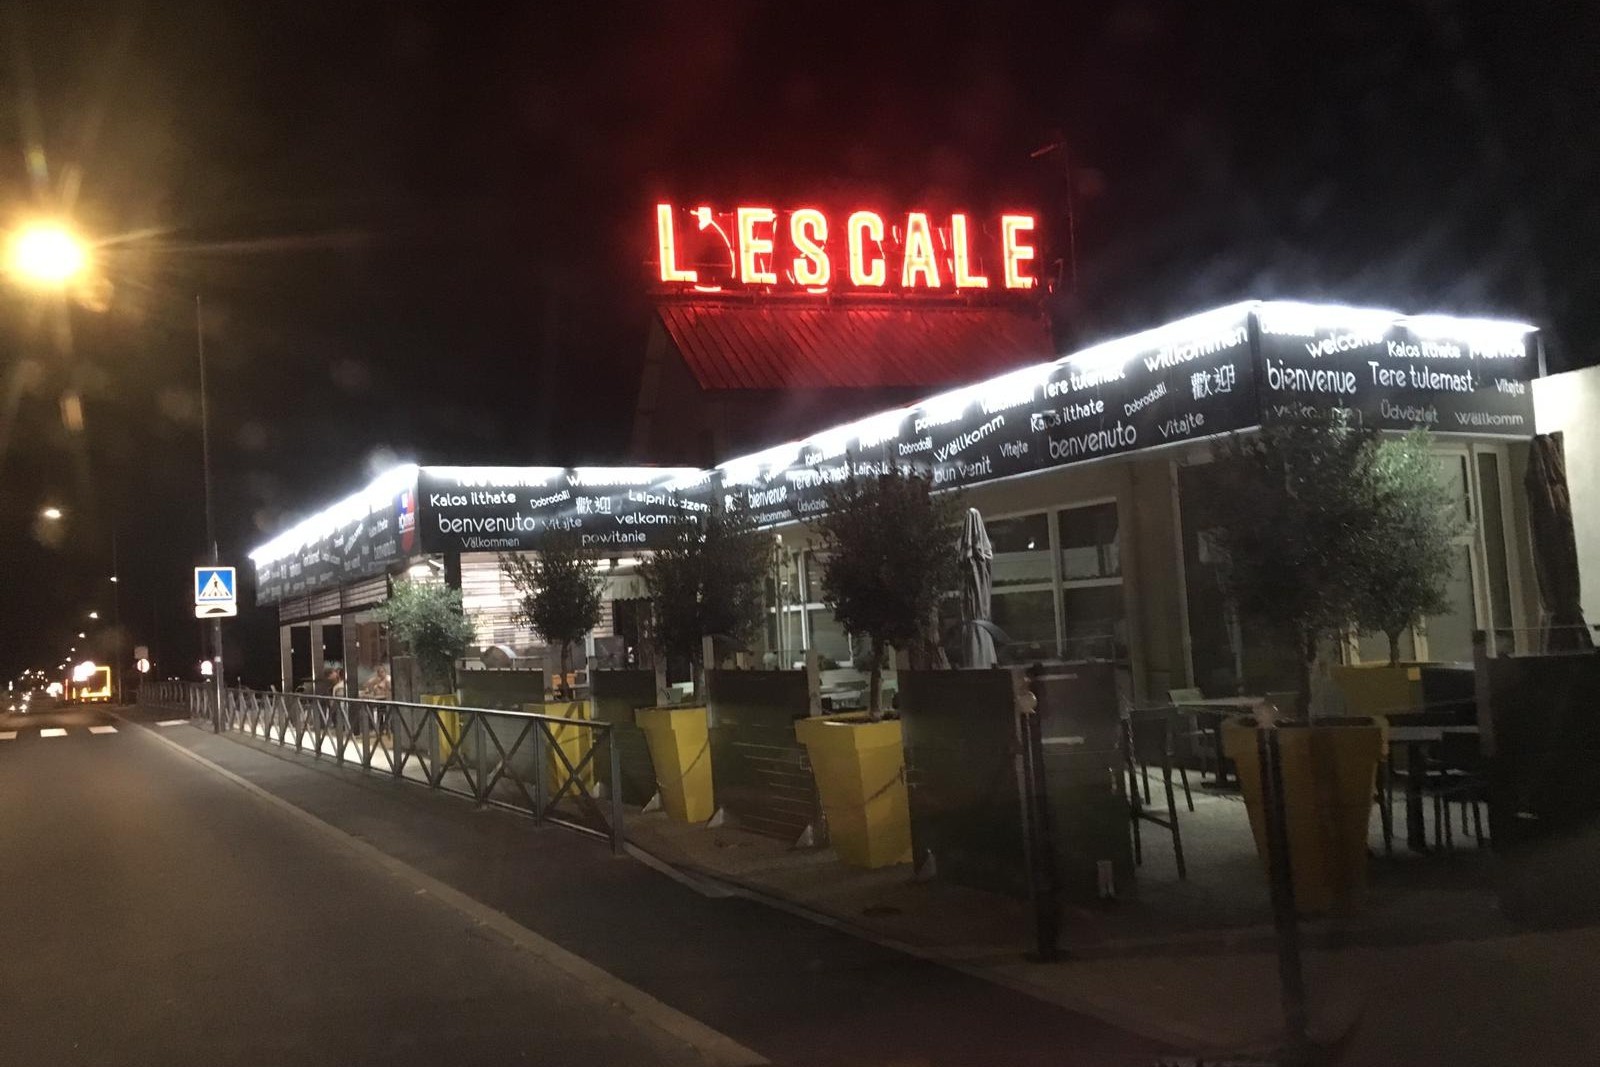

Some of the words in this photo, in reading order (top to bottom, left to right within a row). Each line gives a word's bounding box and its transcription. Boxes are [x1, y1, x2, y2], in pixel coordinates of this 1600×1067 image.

[656, 203, 1036, 291] L'ESCALE
[1266, 358, 1357, 394] bienvenue
[1367, 361, 1407, 388] Tere
[1409, 365, 1475, 393] tulemast
[1158, 411, 1205, 439] Vitajte
[1049, 421, 1137, 460] benvenuto
[934, 462, 957, 484] bun
[959, 456, 993, 479] venit
[429, 492, 468, 507] Kalos
[438, 512, 536, 533] benvenuto
[461, 536, 520, 549] Välkommen
[581, 530, 647, 547] powitanie
